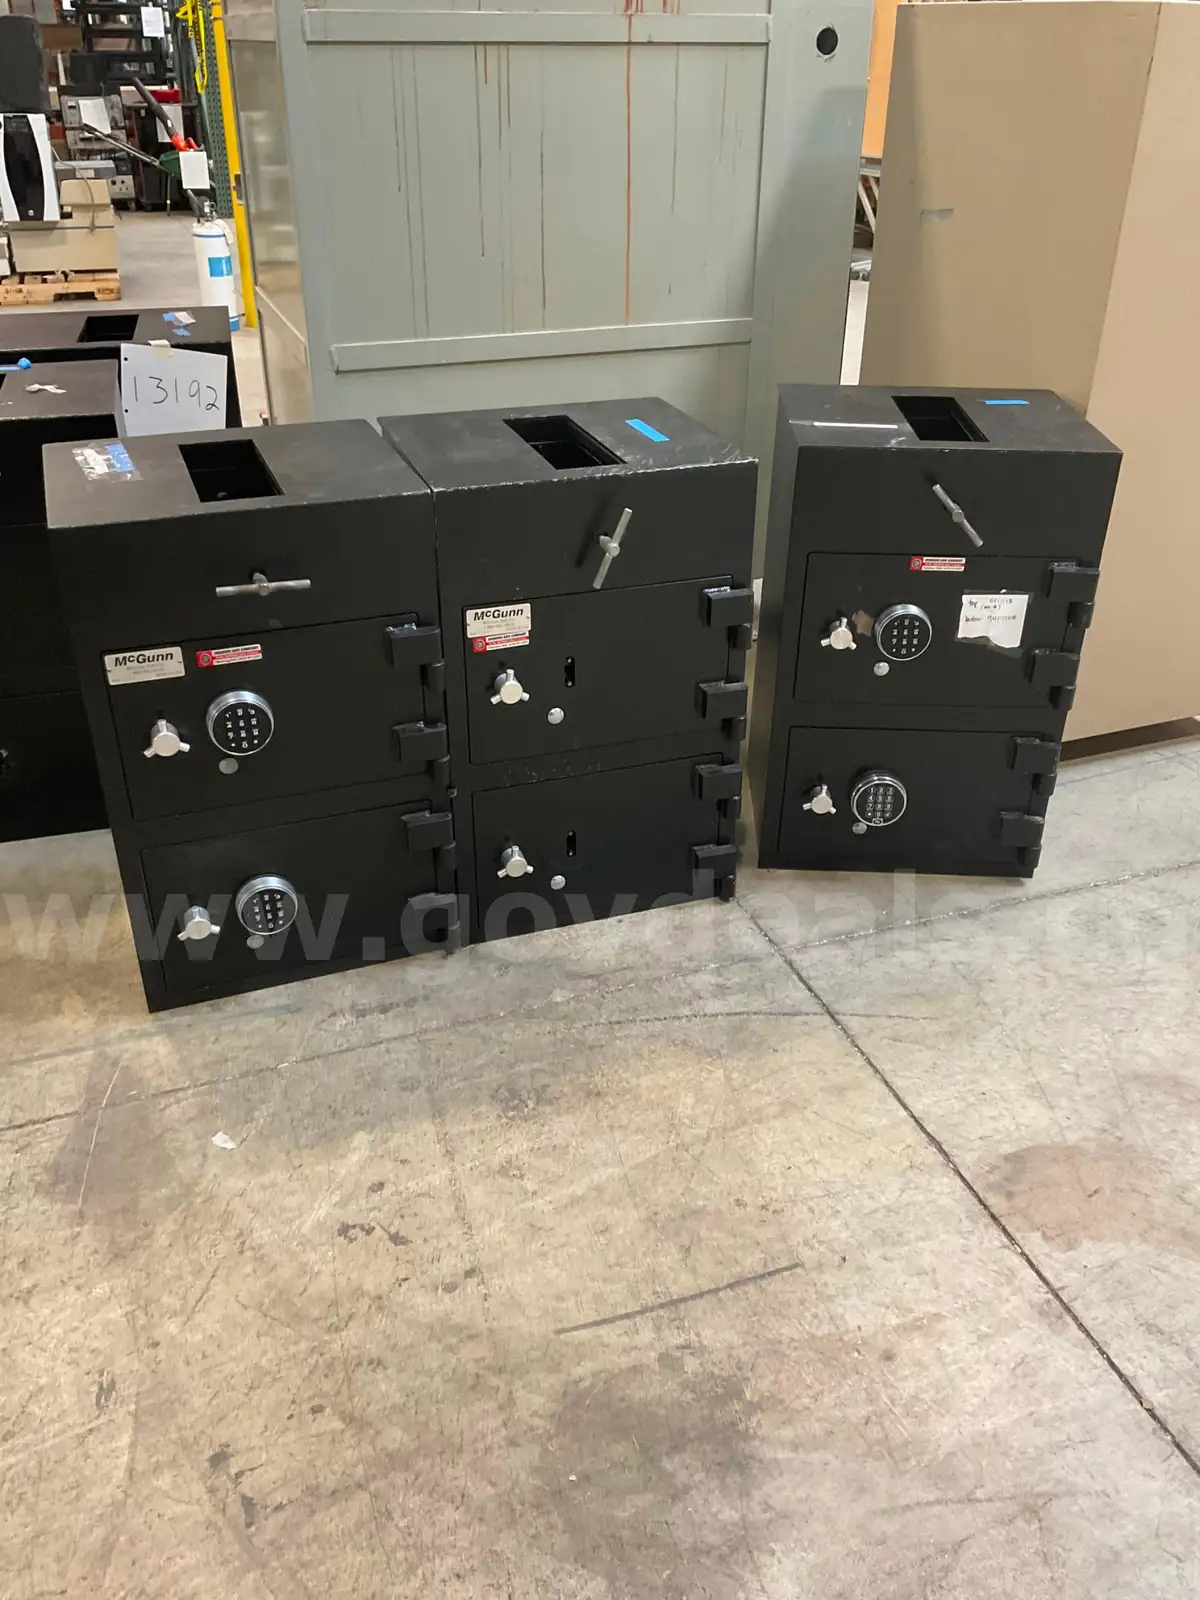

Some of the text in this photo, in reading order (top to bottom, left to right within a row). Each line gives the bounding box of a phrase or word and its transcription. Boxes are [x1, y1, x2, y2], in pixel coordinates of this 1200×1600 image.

[133, 375, 220, 412] 13192
[473, 608, 524, 622] McGunn
[114, 652, 174, 667] McGunn
